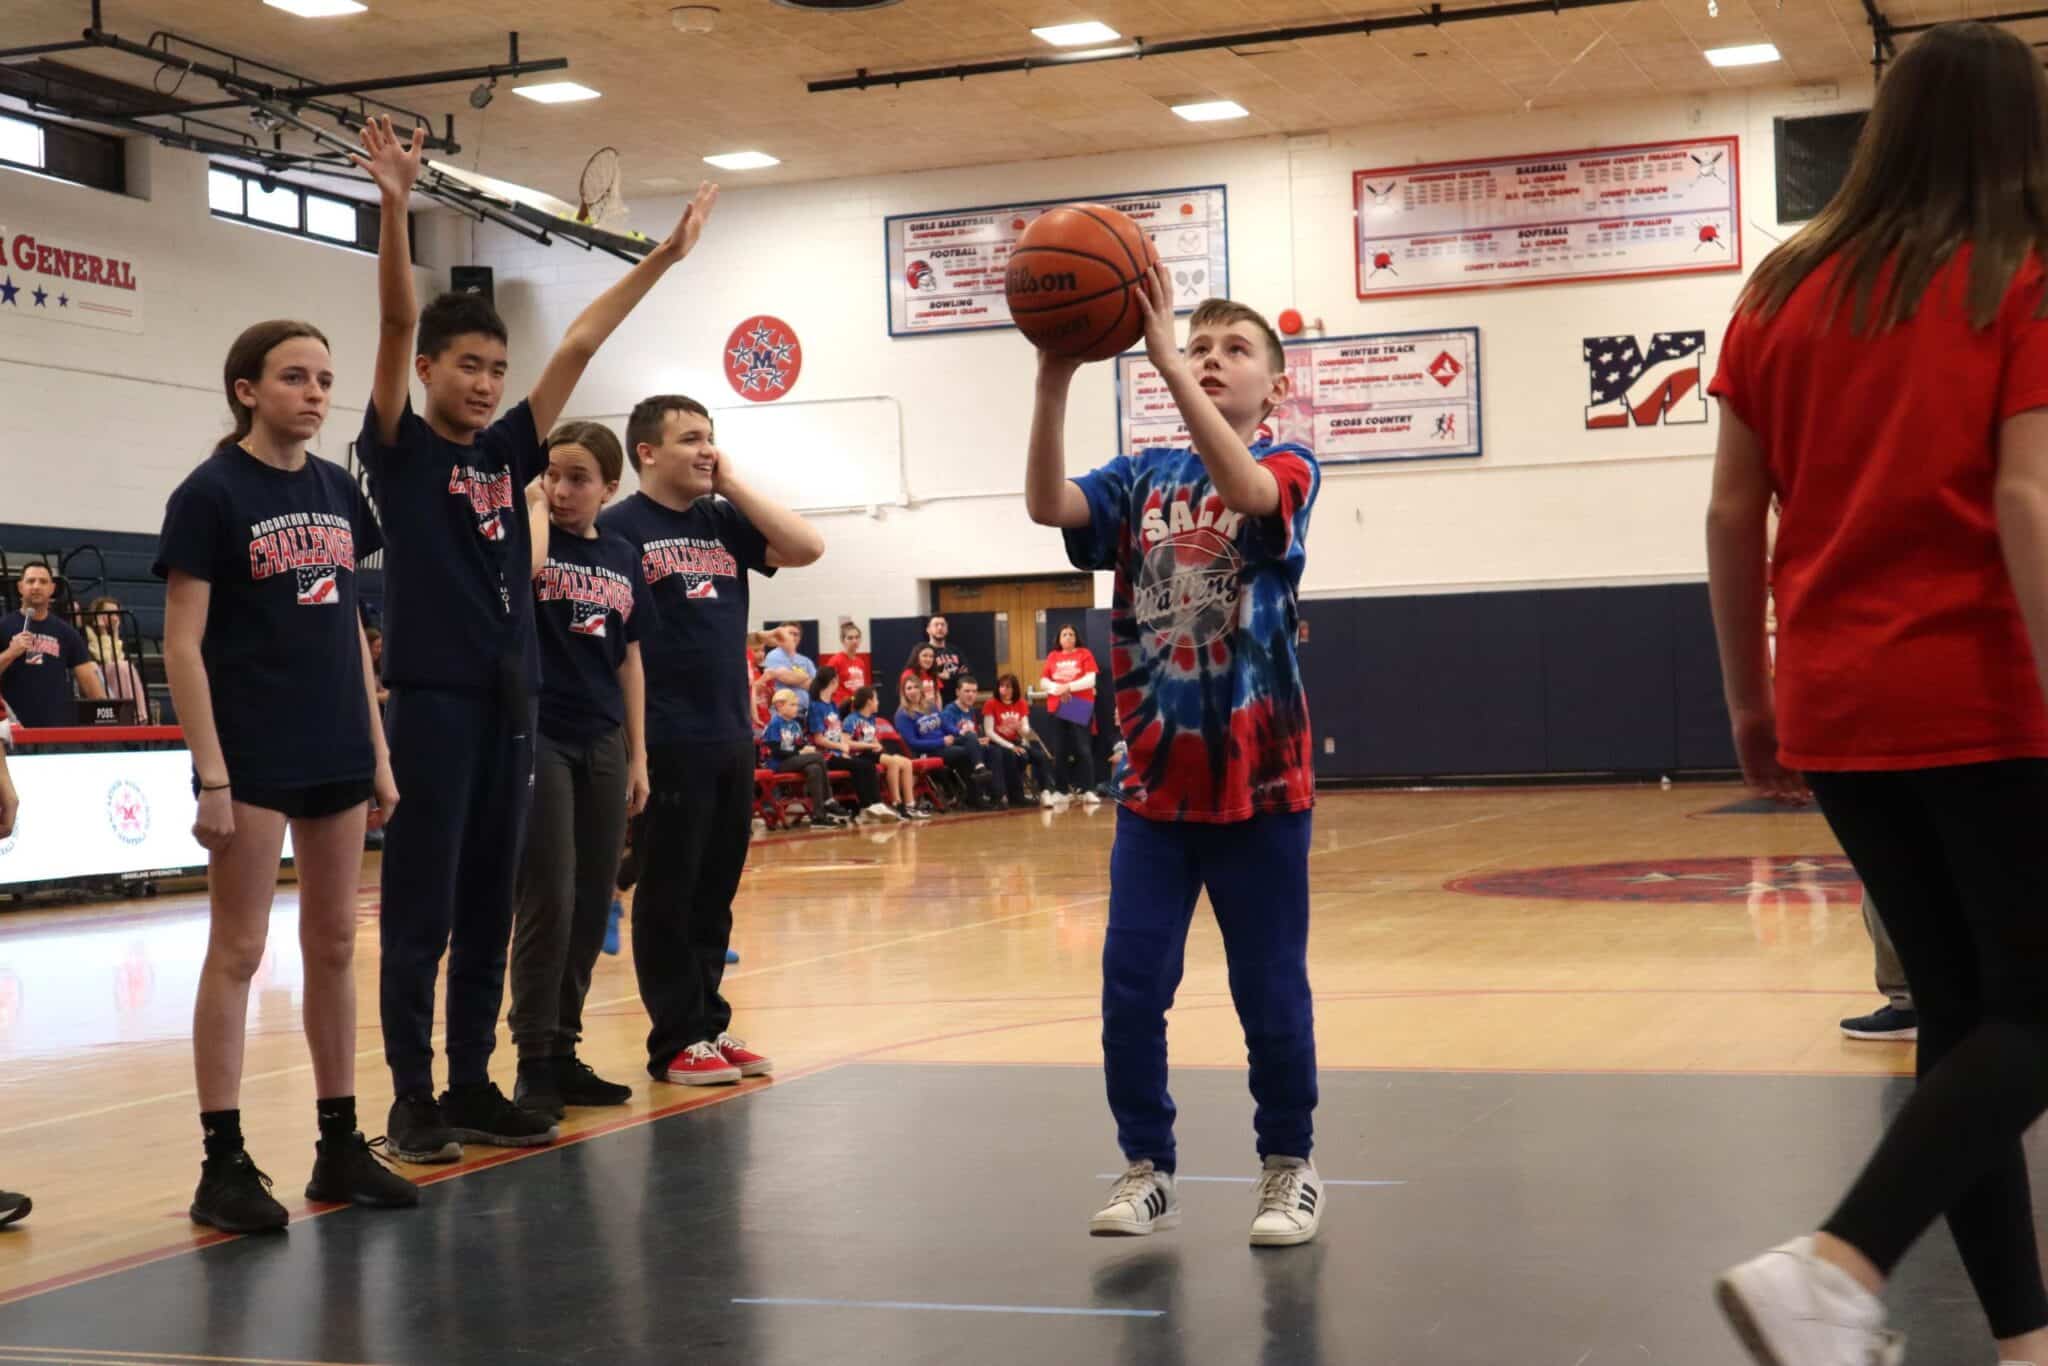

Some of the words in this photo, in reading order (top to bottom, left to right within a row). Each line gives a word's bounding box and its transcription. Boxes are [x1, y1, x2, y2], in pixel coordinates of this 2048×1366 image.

[1516, 162, 1567, 175] BASEBALL
[909, 221, 937, 232] GIRLS
[938, 215, 994, 229] BASKETBALL
[1517, 226, 1569, 239] SOFTBALL
[929, 247, 978, 259] FOOTBALL
[12, 233, 137, 291] GENERAL
[929, 298, 974, 309] BOWLING
[1340, 347, 1380, 357] WINTER
[1383, 344, 1416, 354] TRACK
[1329, 418, 1362, 428] CROSS
[1365, 414, 1414, 425] COUNTRY
[1142, 498, 1244, 543] SALK
